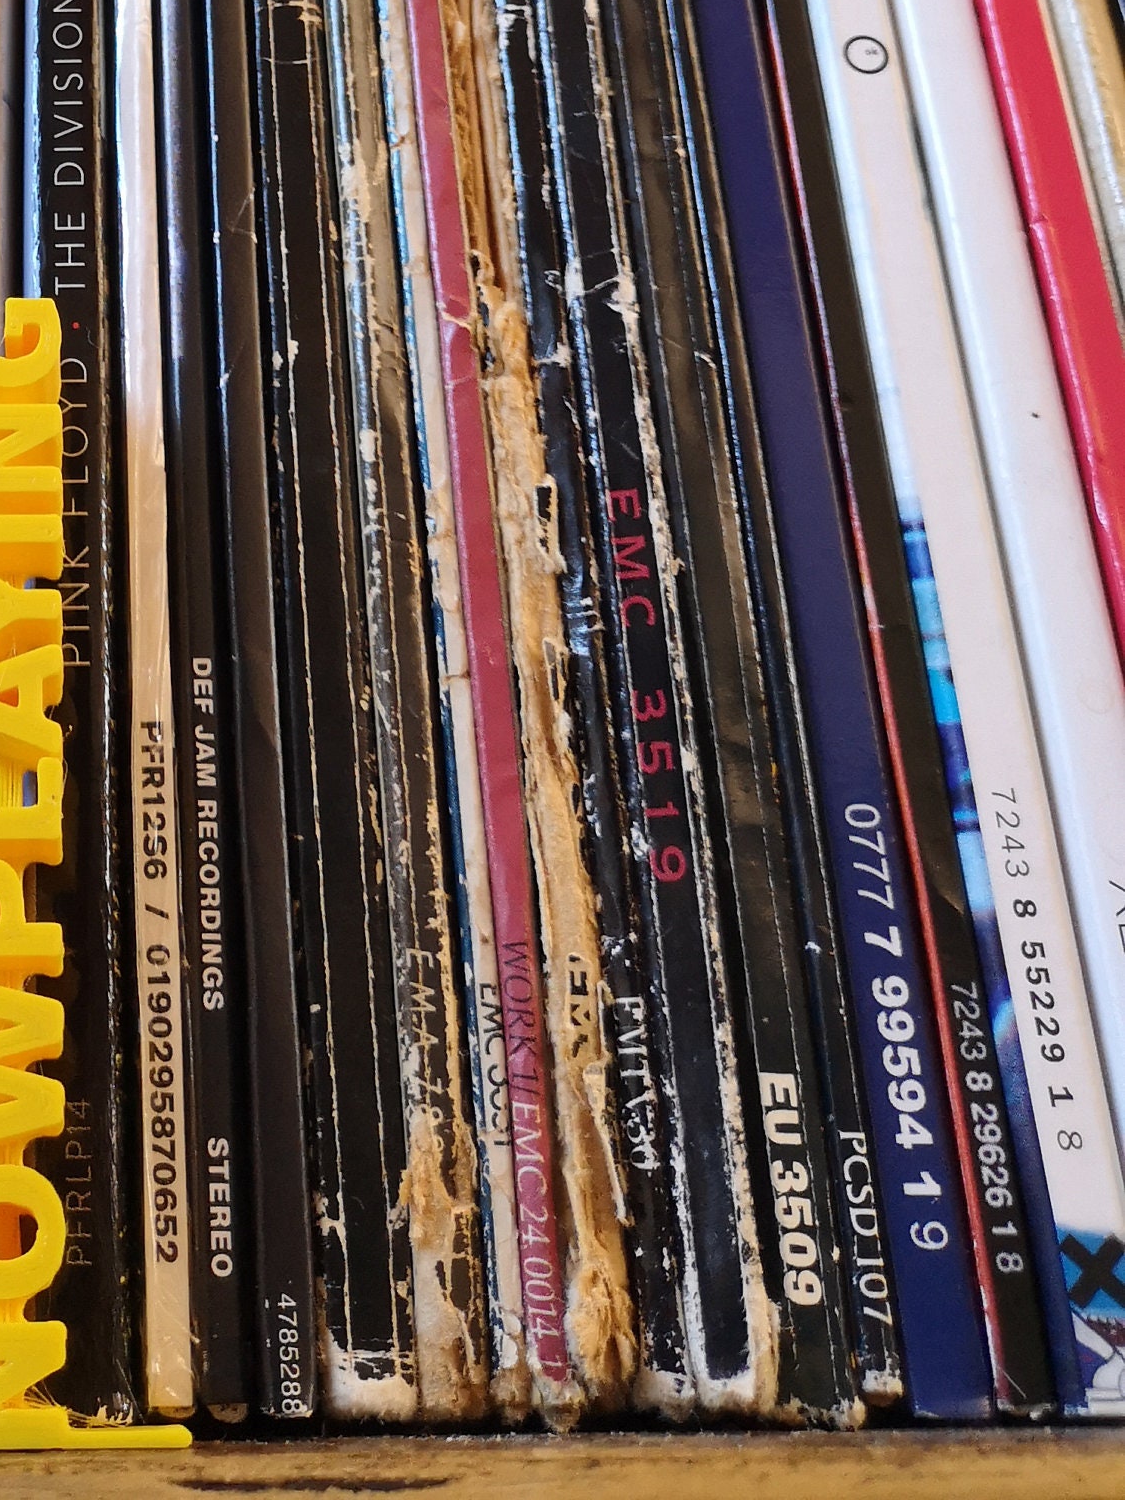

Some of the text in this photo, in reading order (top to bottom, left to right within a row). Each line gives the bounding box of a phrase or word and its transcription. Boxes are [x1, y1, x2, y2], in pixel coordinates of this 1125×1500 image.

[54, 204, 85, 295] THE
[59, 354, 87, 518] FLOYD
[62, 543, 89, 667] PINK
[604, 486, 688, 885] EMC 3519
[136, 718, 169, 880] PFR12S6
[190, 657, 225, 1012] DEF JAM RECORDINGS
[498, 938, 539, 1060] WORK
[842, 799, 948, 1255] 0777 7 99594 1 9
[987, 784, 1086, 1155] 7243 8 55229 1 8
[63, 1097, 95, 1267] PFRLP14
[141, 942, 181, 1265] 0190295870652
[757, 1067, 824, 1310] EU 3509
[946, 978, 1026, 1277] 7243 8 29626 1 8
[206, 1135, 234, 1278] STEREO
[835, 1126, 895, 1330] PCSD 107
[272, 1291, 303, 1416] 4785288
